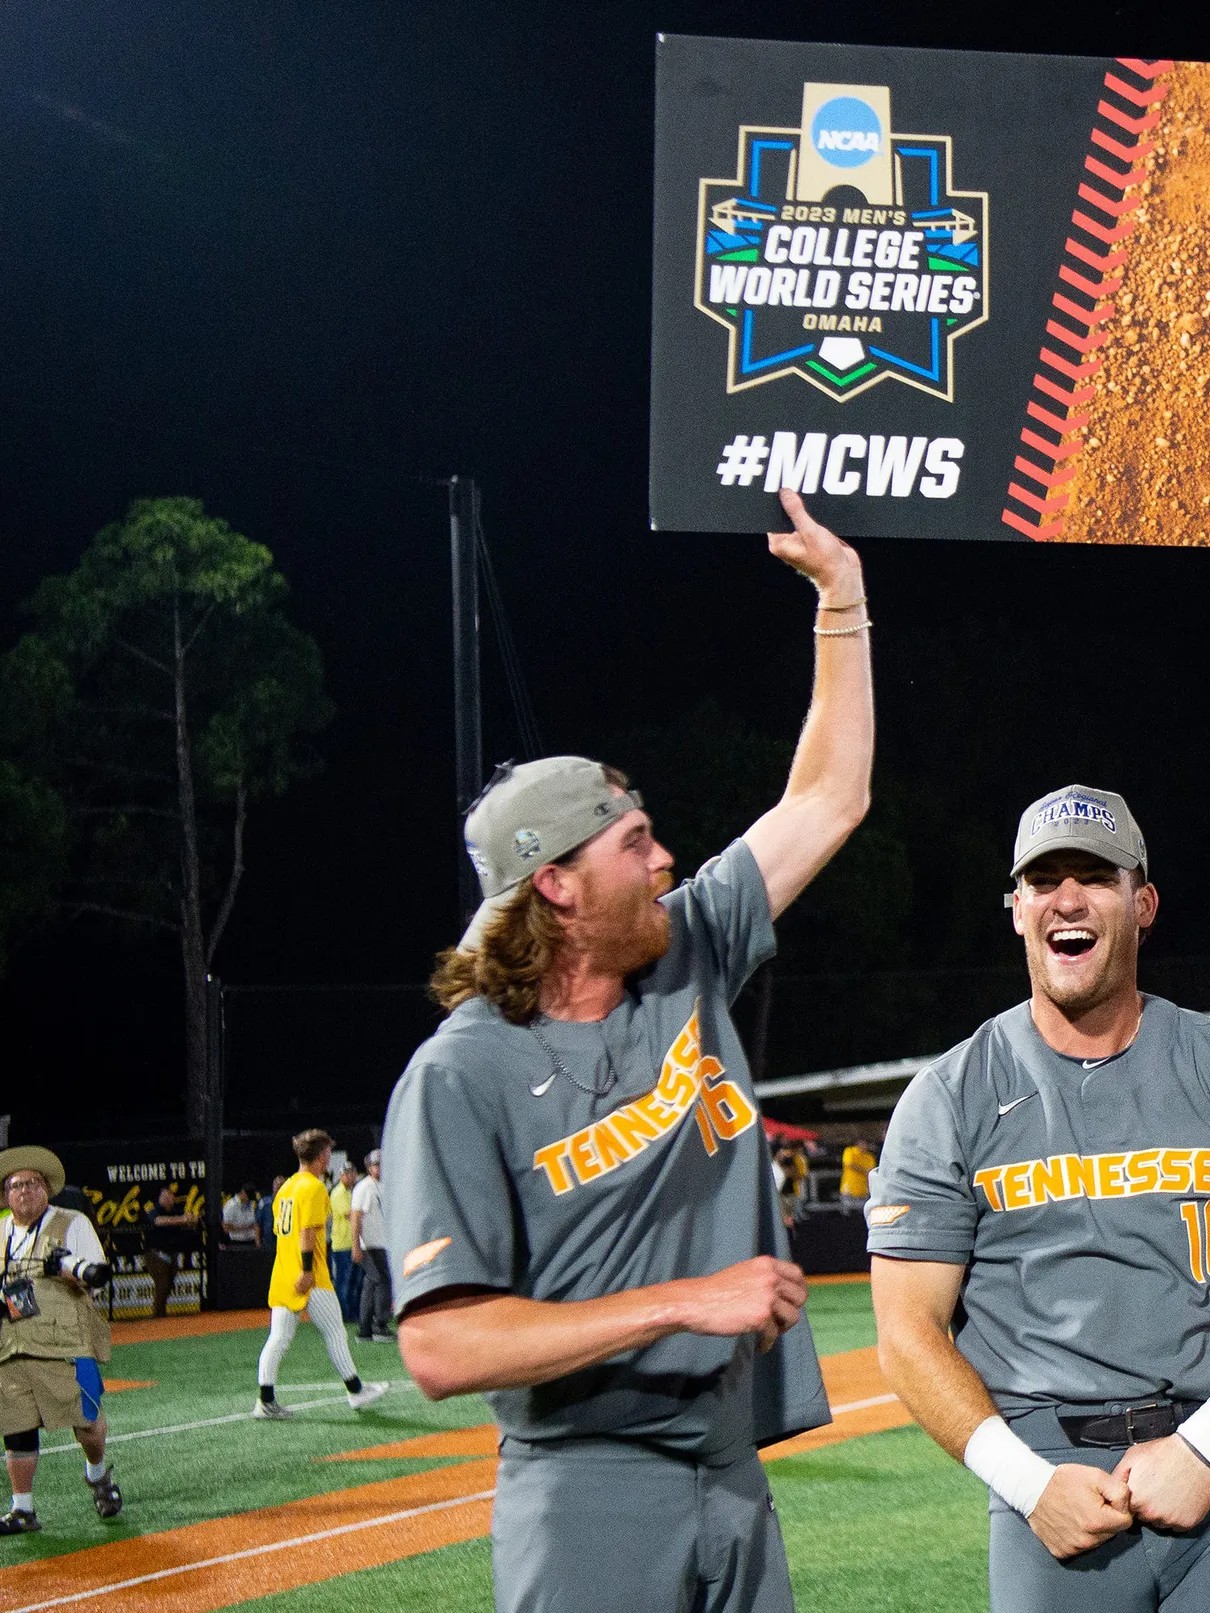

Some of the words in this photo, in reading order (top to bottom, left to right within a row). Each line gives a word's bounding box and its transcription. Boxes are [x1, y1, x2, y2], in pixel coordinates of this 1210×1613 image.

[817, 129, 880, 152] NCAA
[781, 205, 837, 222] 2023
[842, 207, 906, 225] MEN'S
[764, 224, 924, 270] COLLEGE
[709, 264, 841, 308] WORLD
[845, 271, 977, 314] SERIES
[803, 314, 883, 333] OMAHA
[716, 431, 965, 498] #MCWS
[1031, 800, 1117, 838] CHAMPS
[107, 1162, 166, 1182] WELCOME
[170, 1161, 186, 1180] TO
